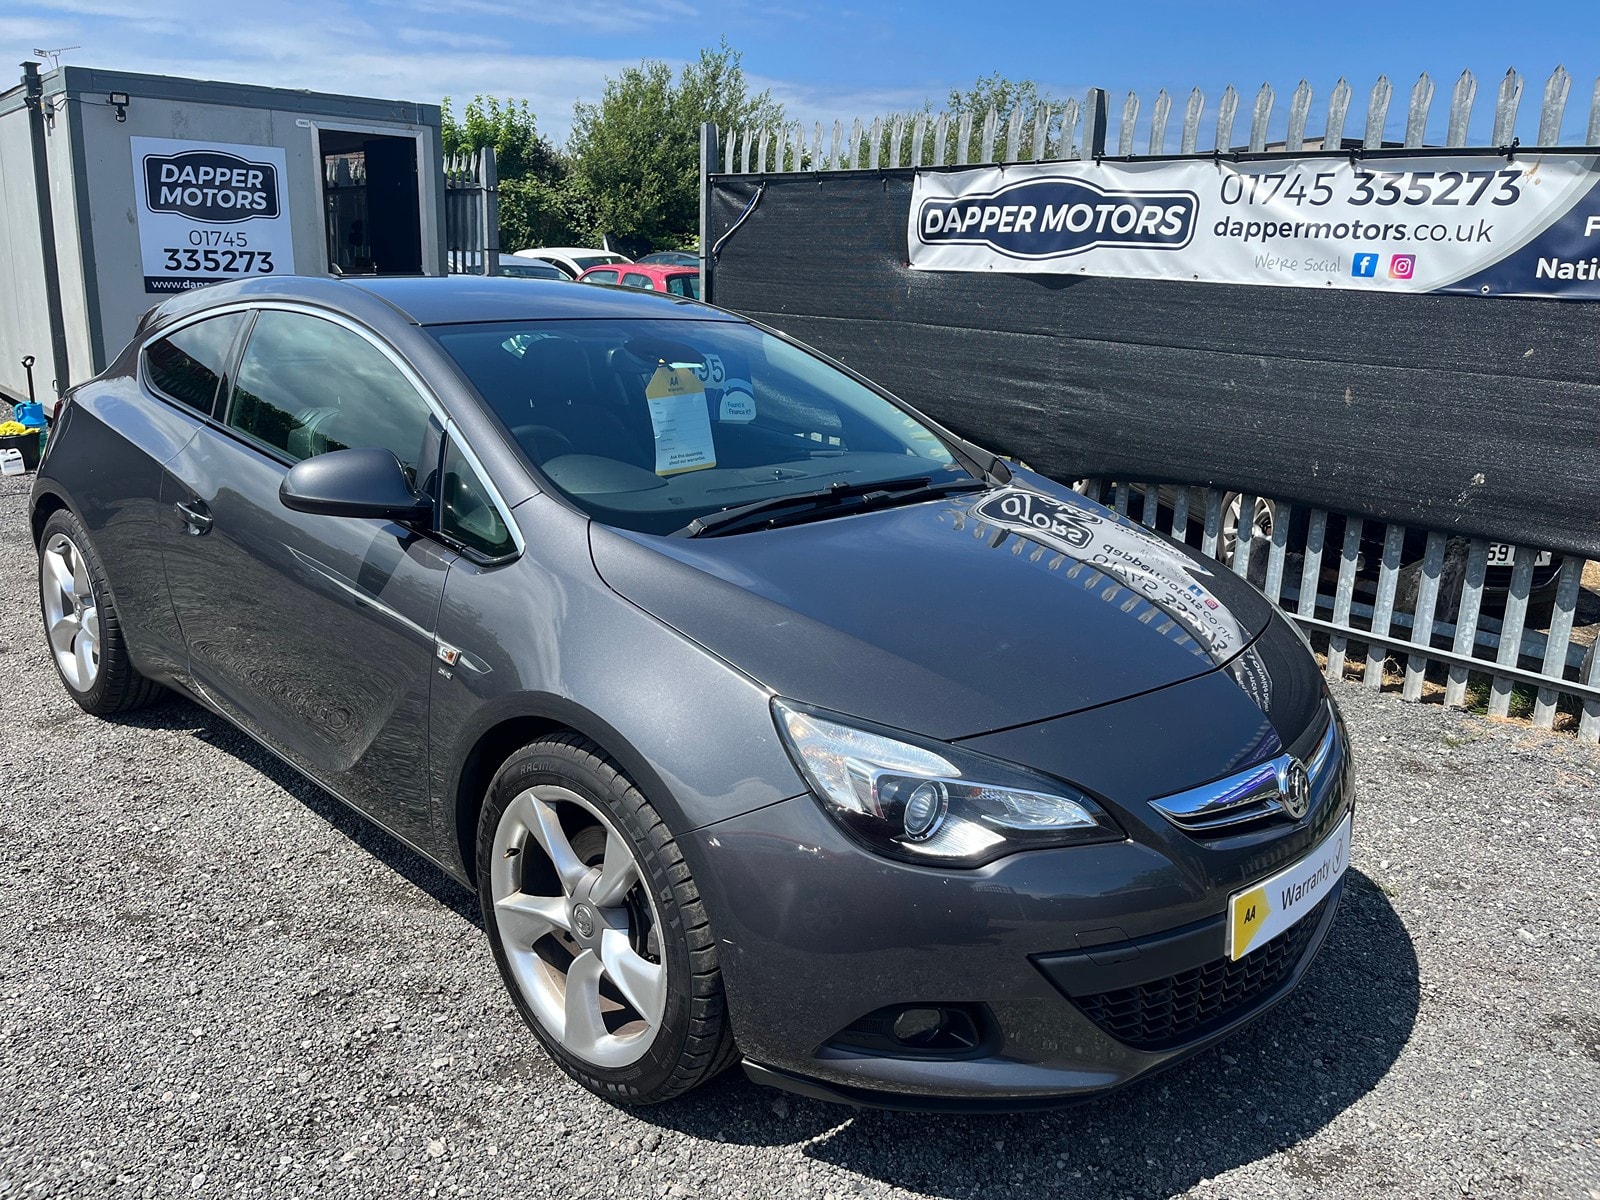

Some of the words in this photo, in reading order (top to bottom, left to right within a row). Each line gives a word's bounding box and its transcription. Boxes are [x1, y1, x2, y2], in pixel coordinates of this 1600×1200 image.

[160, 164, 264, 189] DAPPER
[1219, 173, 1336, 206] 01745
[1347, 170, 1523, 207] 335273
[159, 186, 268, 210] MOTORS
[924, 206, 1034, 234] DAPPER
[1039, 203, 1187, 236] MOTORS
[1213, 217, 1494, 243] dappermotors.co.uk
[188, 229, 248, 248] 01745
[163, 248, 274, 273] 335273
[1303, 256, 1342, 274] Social
[1535, 257, 1600, 281] Nati
[669, 376, 679, 387] AA
[689, 358, 724, 383] 95
[1281, 858, 1330, 910] Warranty
[1243, 904, 1257, 925] AA
